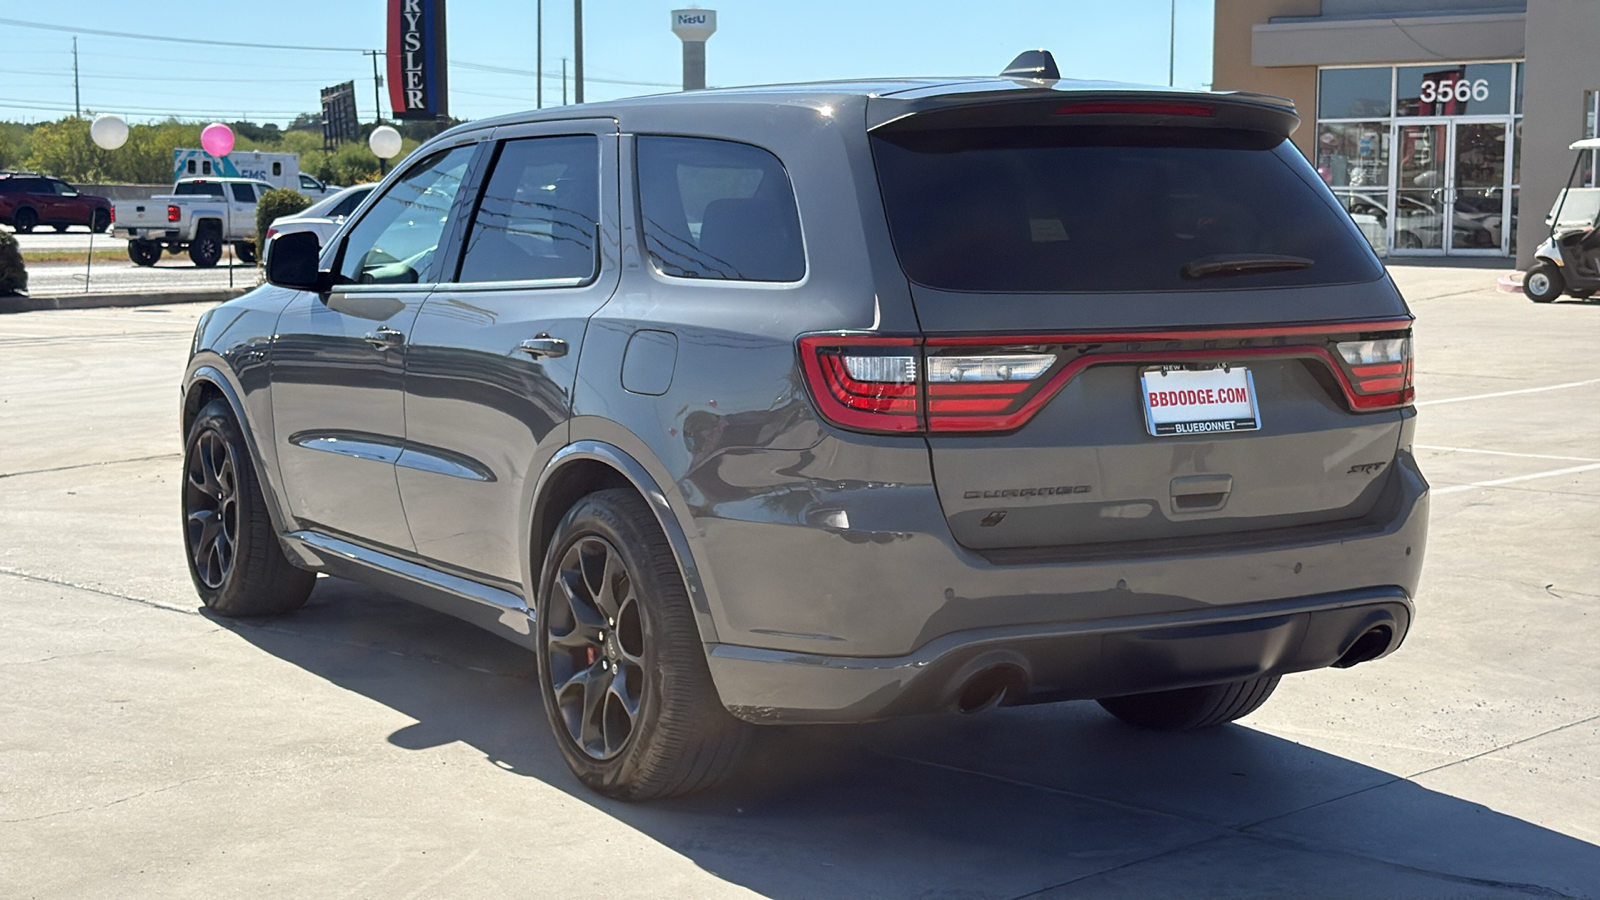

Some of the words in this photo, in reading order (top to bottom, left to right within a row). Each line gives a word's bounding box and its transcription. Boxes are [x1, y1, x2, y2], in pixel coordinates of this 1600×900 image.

[678, 14, 706, 24] NBU
[1420, 79, 1489, 103] 3566
[241, 169, 267, 180] EMS
[1149, 387, 1247, 408] BBDODGE.COM
[1175, 420, 1236, 433] BLUEBONNET
